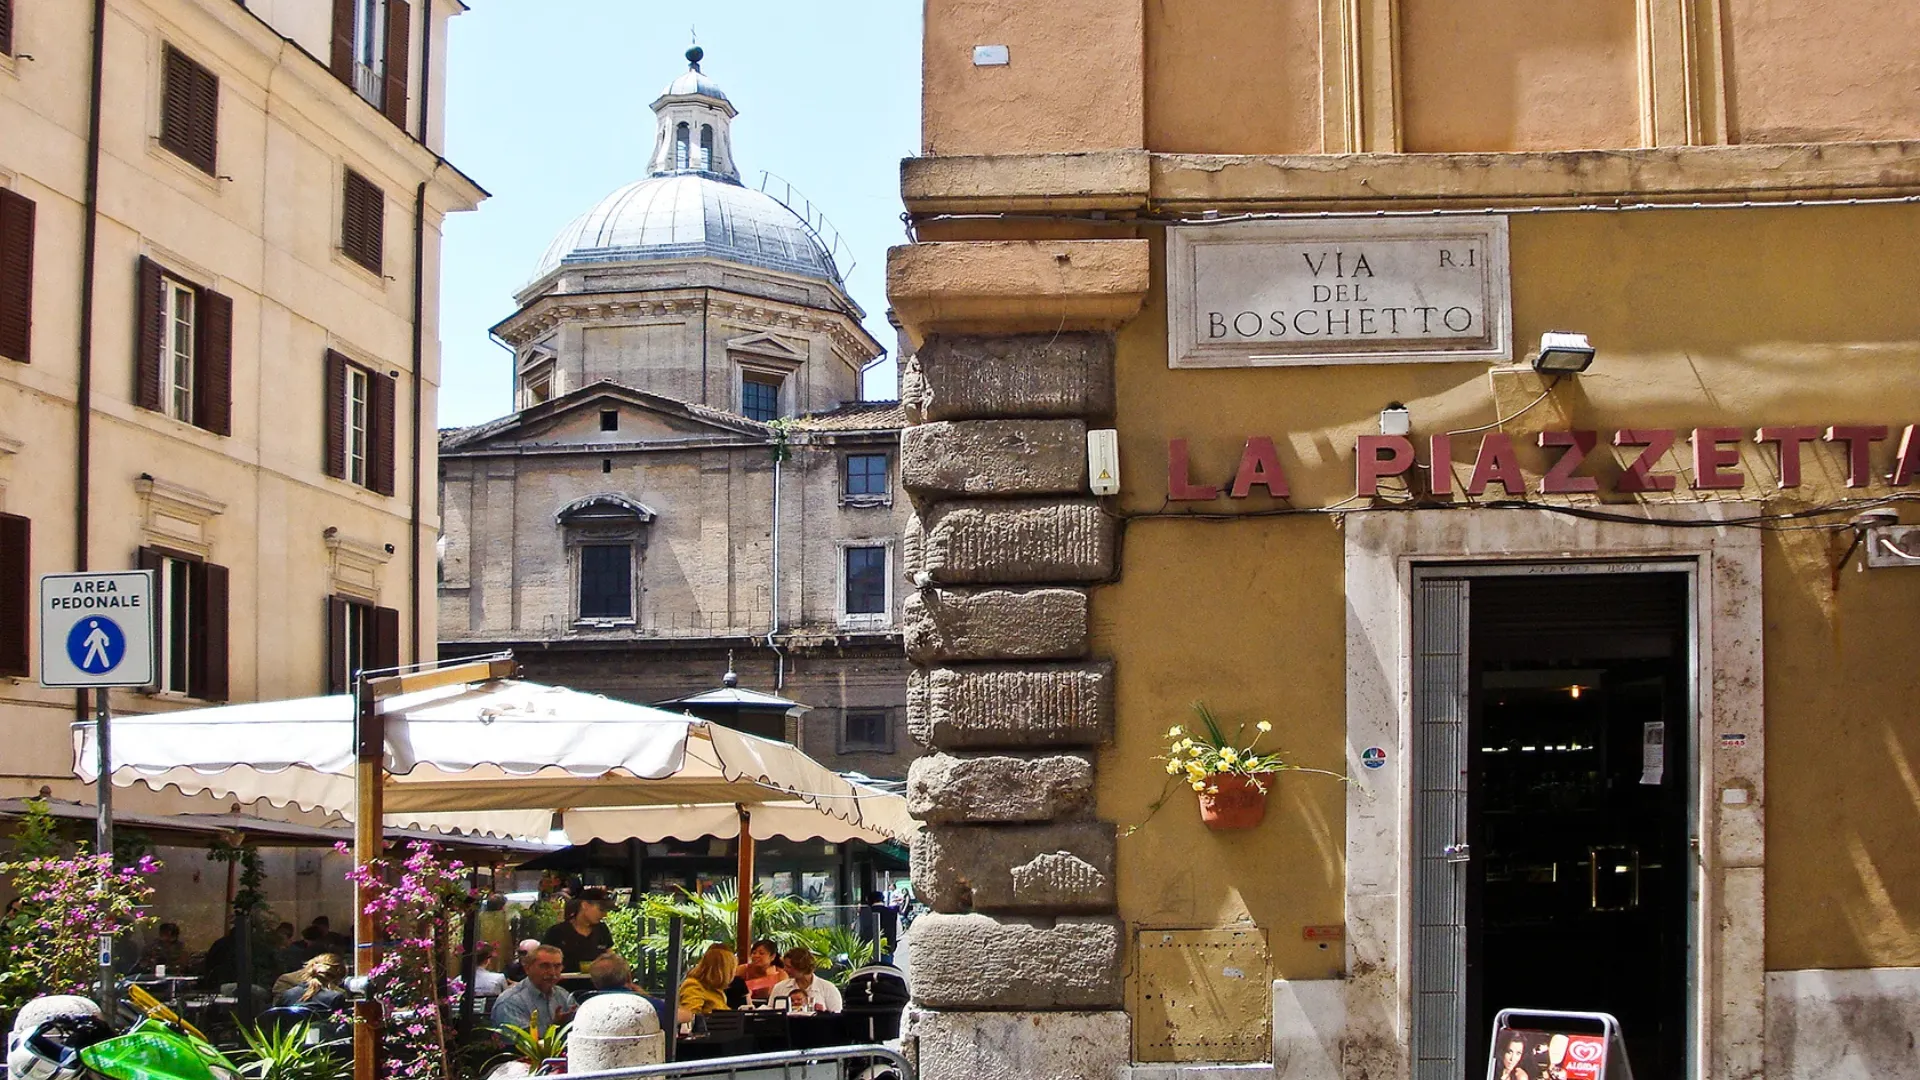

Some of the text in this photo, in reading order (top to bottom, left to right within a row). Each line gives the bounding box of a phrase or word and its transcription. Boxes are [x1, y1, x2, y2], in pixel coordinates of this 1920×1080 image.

[1302, 252, 1375, 278] VIA
[1312, 284, 1368, 303] DEL
[1208, 306, 1472, 339] BOSCHETTO
[1167, 436, 1290, 500] LA
[73, 580, 117, 593] AREA
[51, 595, 141, 610] PEDONALE
